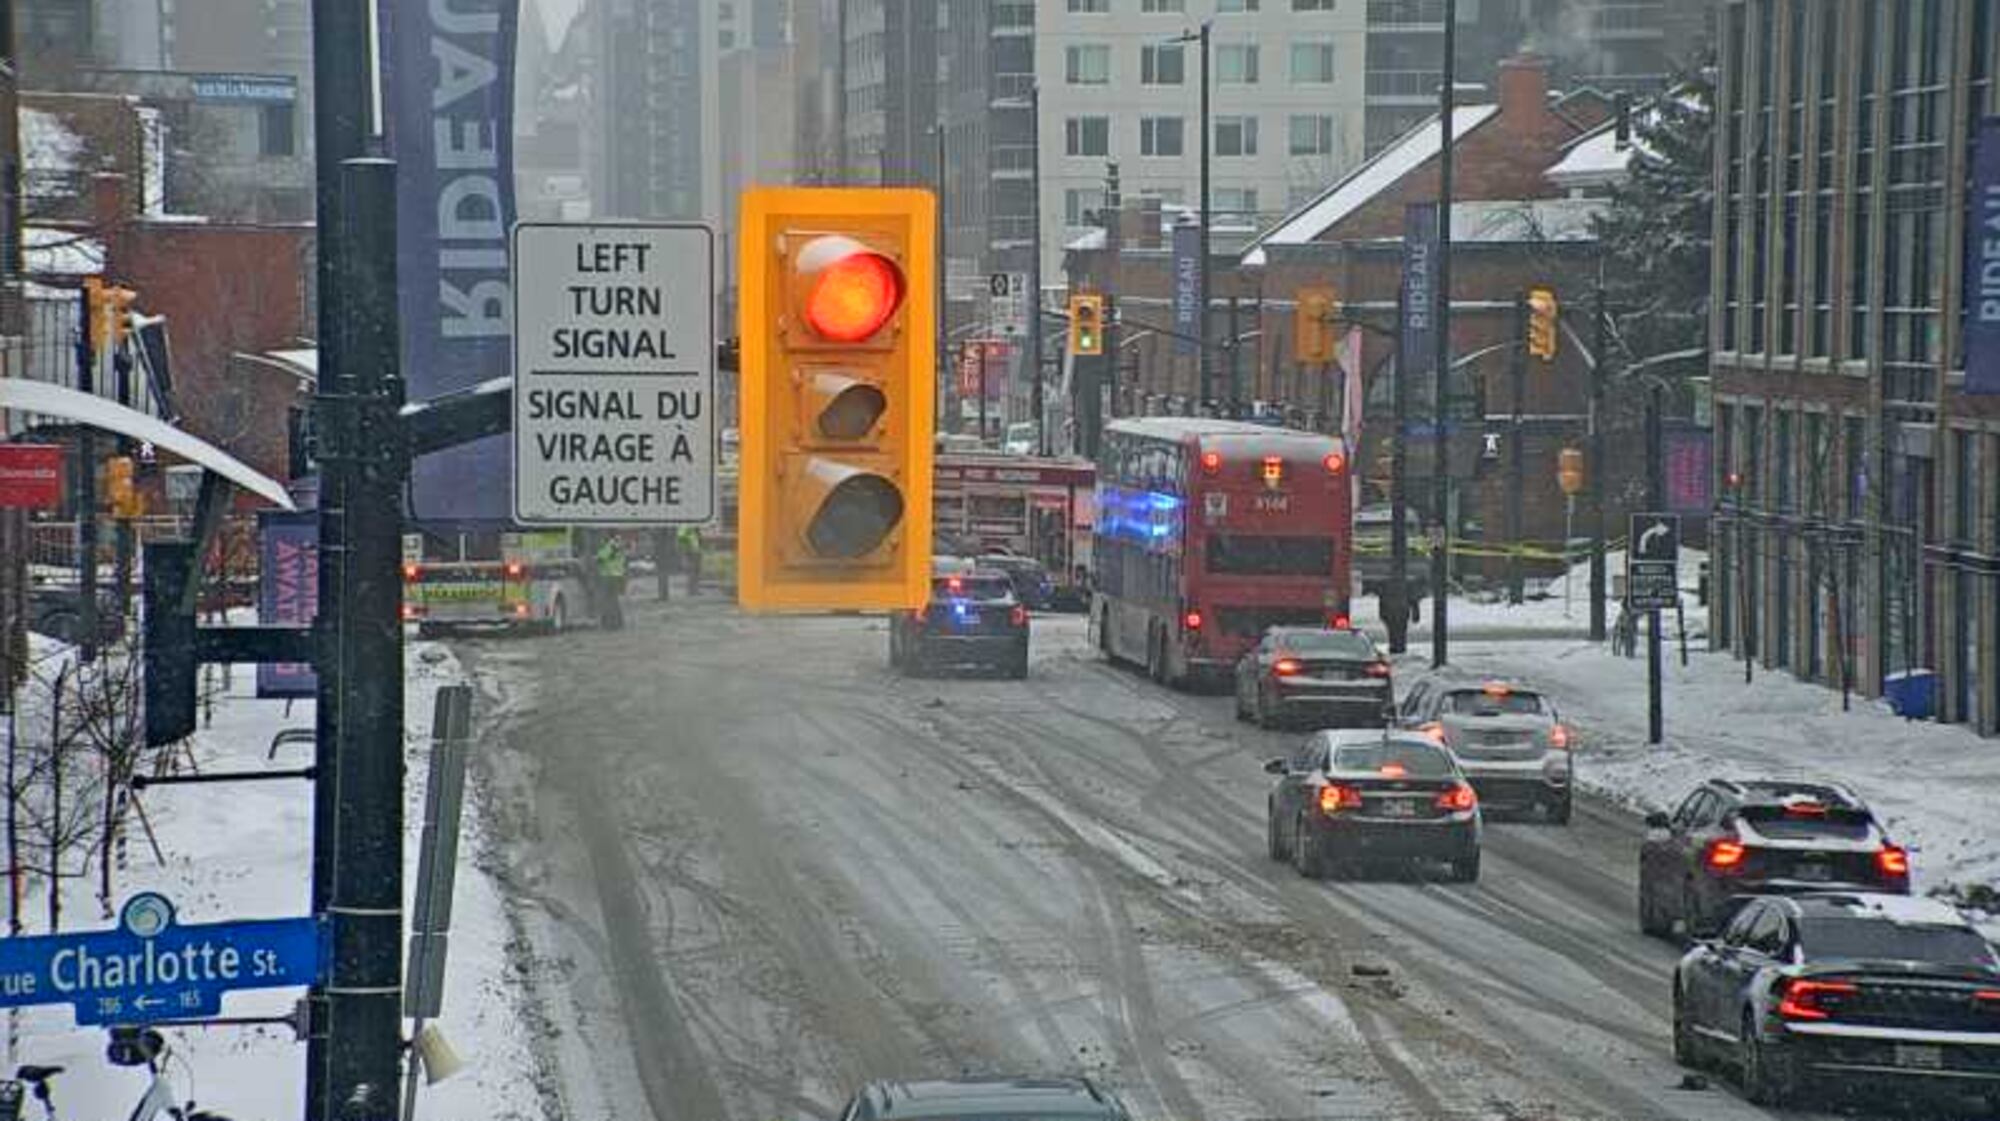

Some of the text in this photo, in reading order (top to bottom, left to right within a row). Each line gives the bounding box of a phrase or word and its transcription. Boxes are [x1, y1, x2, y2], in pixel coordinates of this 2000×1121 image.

[577, 243, 650, 272] LEFT
[568, 286, 661, 315] TURN
[1179, 258, 1195, 322] RIDEAU
[1409, 243, 1429, 329] RIDEAU
[552, 329, 676, 359] SIGNAL
[528, 390, 701, 420] SIGNAL DU
[537, 424, 694, 463] VIRAGE À
[548, 475, 682, 505] GAUCHE
[51, 939, 240, 991] Charlotte
[253, 948, 286, 977] St.
